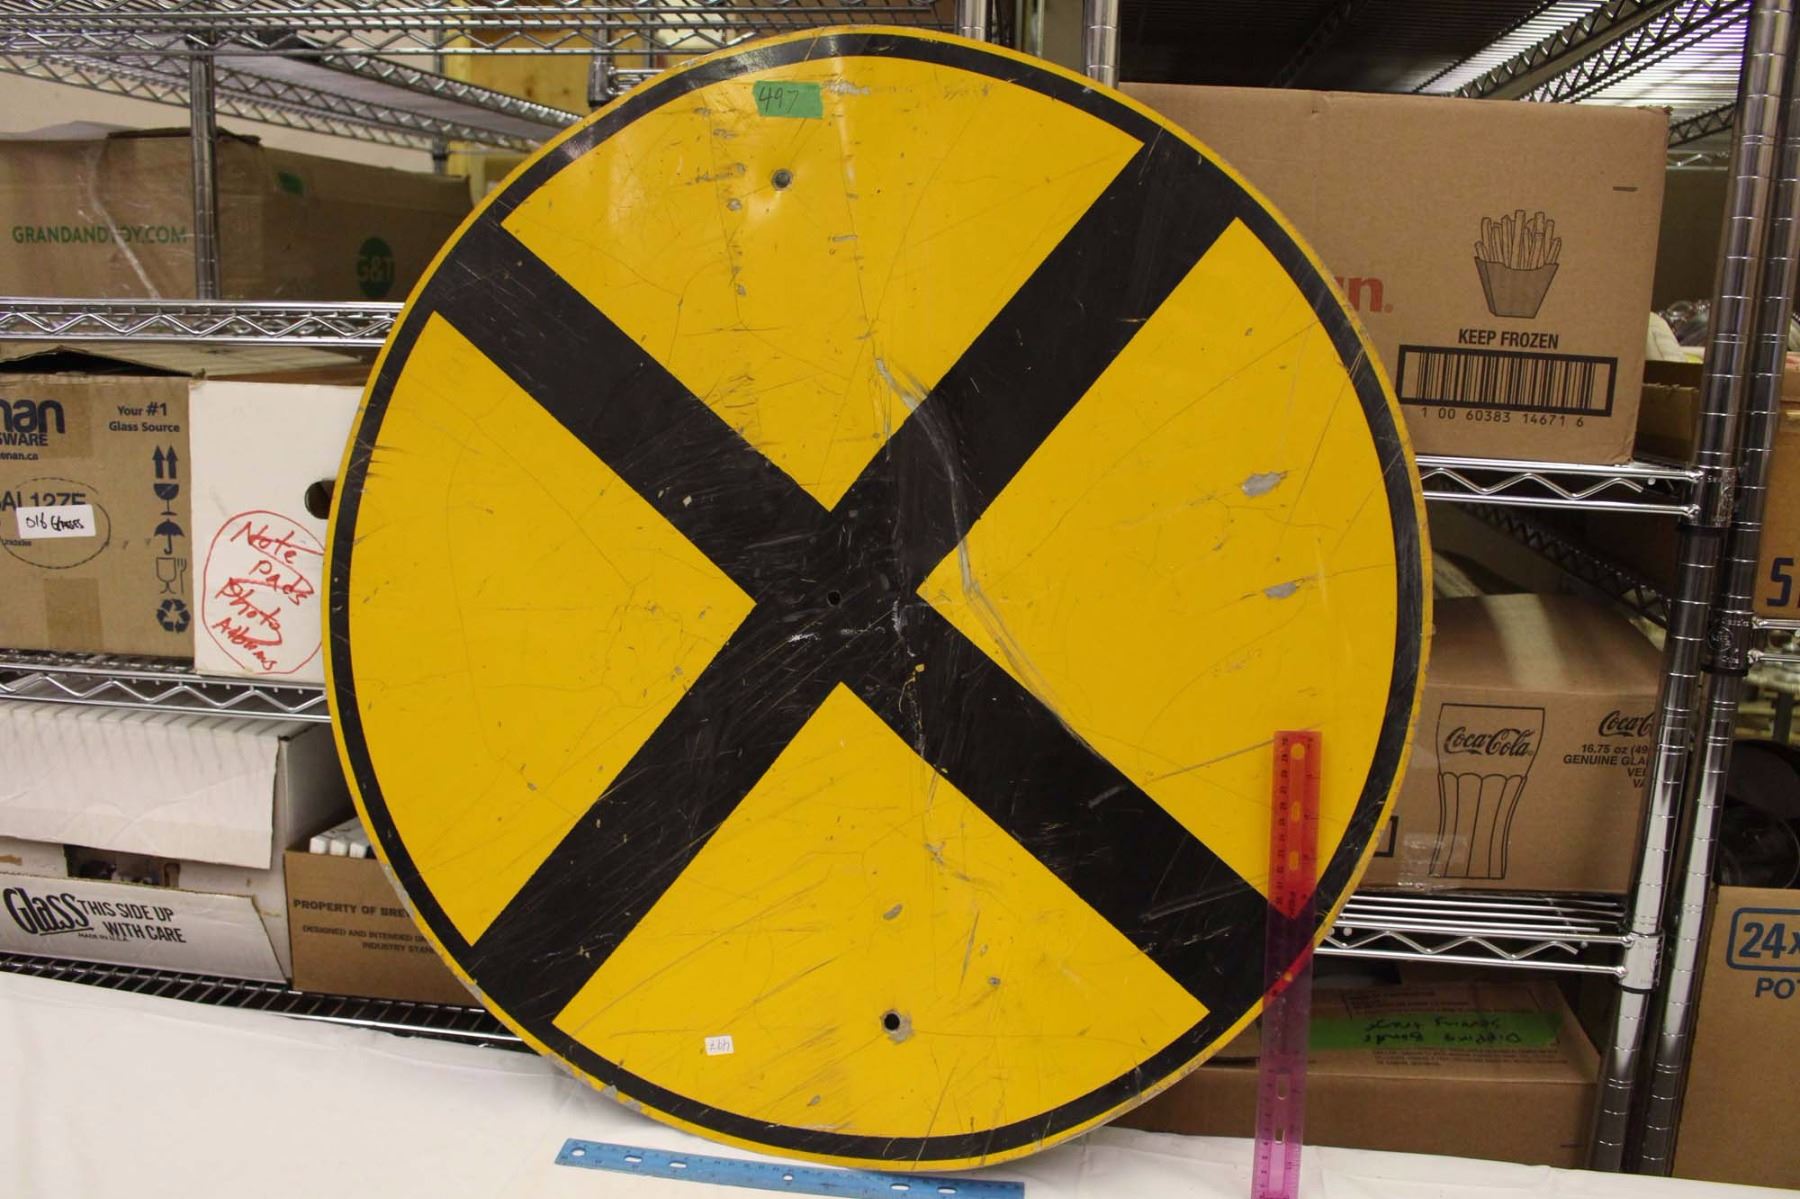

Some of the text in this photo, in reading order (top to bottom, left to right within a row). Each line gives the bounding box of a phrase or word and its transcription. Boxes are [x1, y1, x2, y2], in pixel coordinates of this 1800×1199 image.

[758, 87, 800, 113] 497
[1458, 328, 1559, 349] KEEP FROZEN
[117, 401, 167, 416] Your #1
[1421, 407, 1585, 427] 1 00 60383 14671 6
[109, 420, 180, 432] Glass Source
[0, 433, 48, 446] WARE
[1444, 726, 1535, 756] Coca-Cola
[1581, 744, 1610, 754] 16.75
[1614, 746, 1628, 754] oz
[1563, 755, 1648, 766] GENUINE GLA
[3, 887, 90, 935] Glass
[77, 899, 174, 922] THIS SIDE UP
[294, 900, 357, 913] PROPERTY
[361, 905, 376, 916] OF
[102, 921, 187, 943] WITH CARE
[1755, 977, 1800, 999] PO
